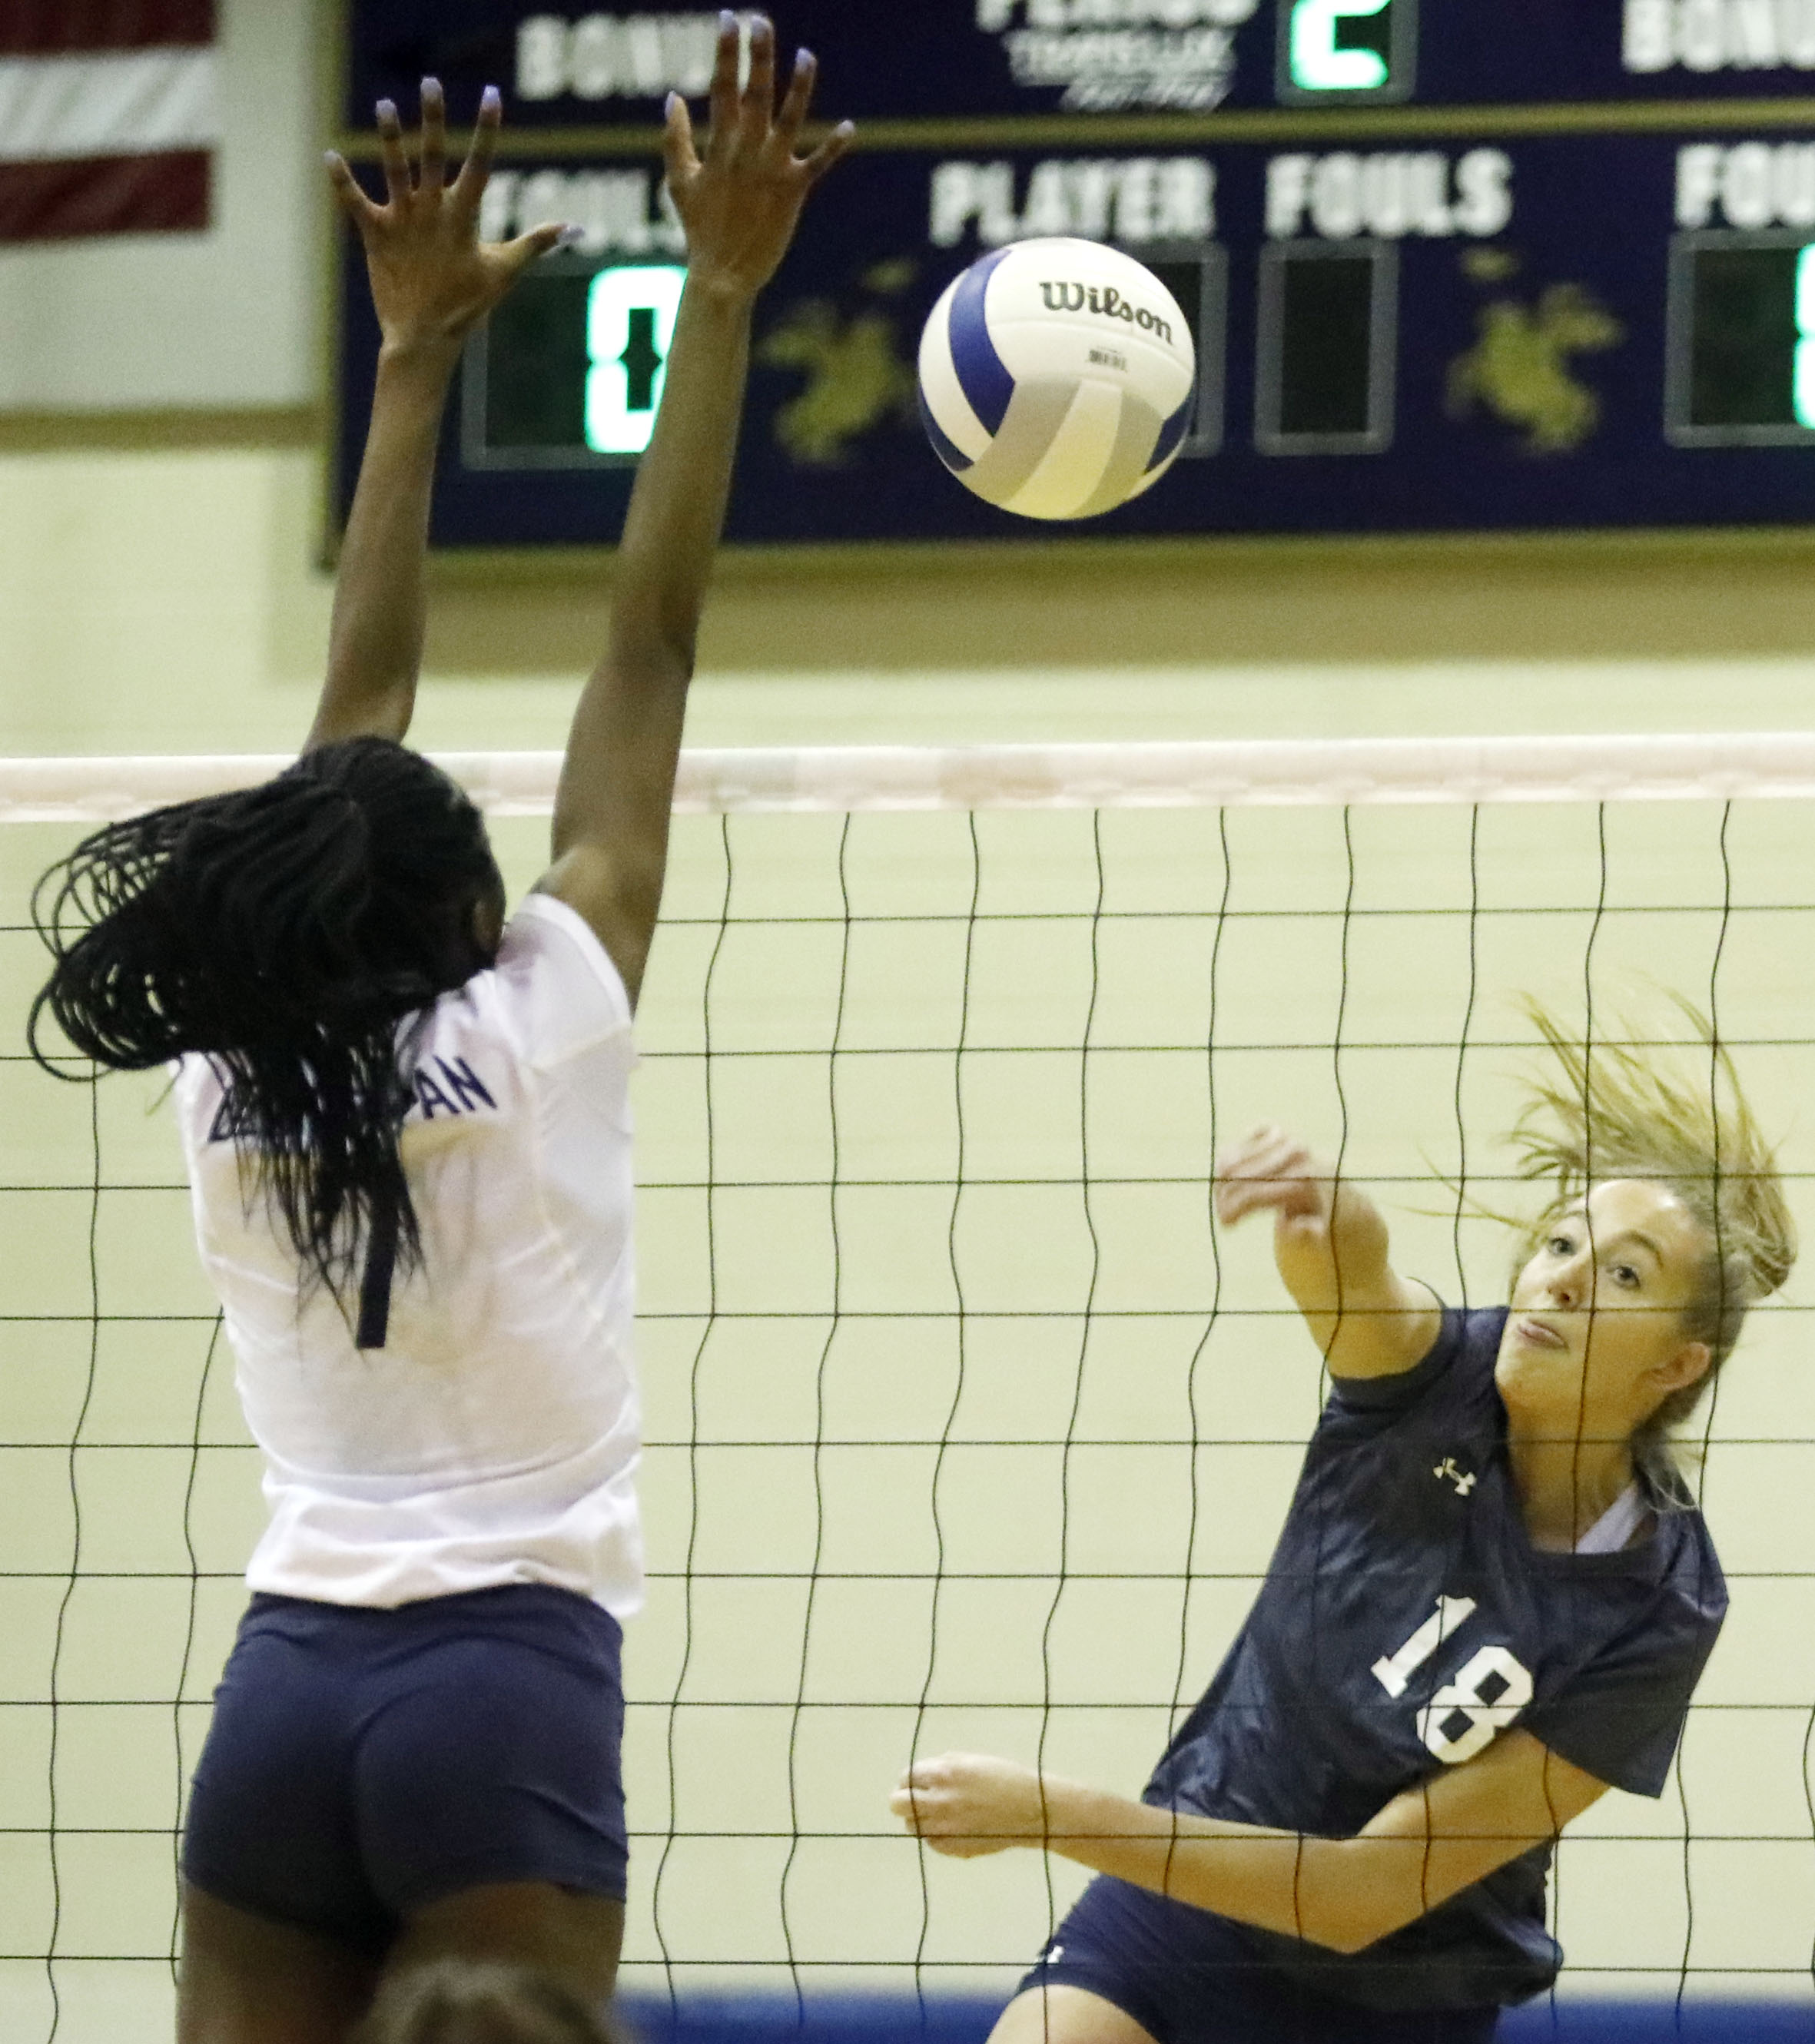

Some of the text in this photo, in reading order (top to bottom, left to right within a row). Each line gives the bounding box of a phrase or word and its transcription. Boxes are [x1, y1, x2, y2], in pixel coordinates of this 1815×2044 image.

[516, 10, 770, 101] BONU
[930, 148, 1513, 247] PLAYER FOULS
[1039, 281, 1173, 345] Wilson
[1371, 1594, 1534, 1764] 18
